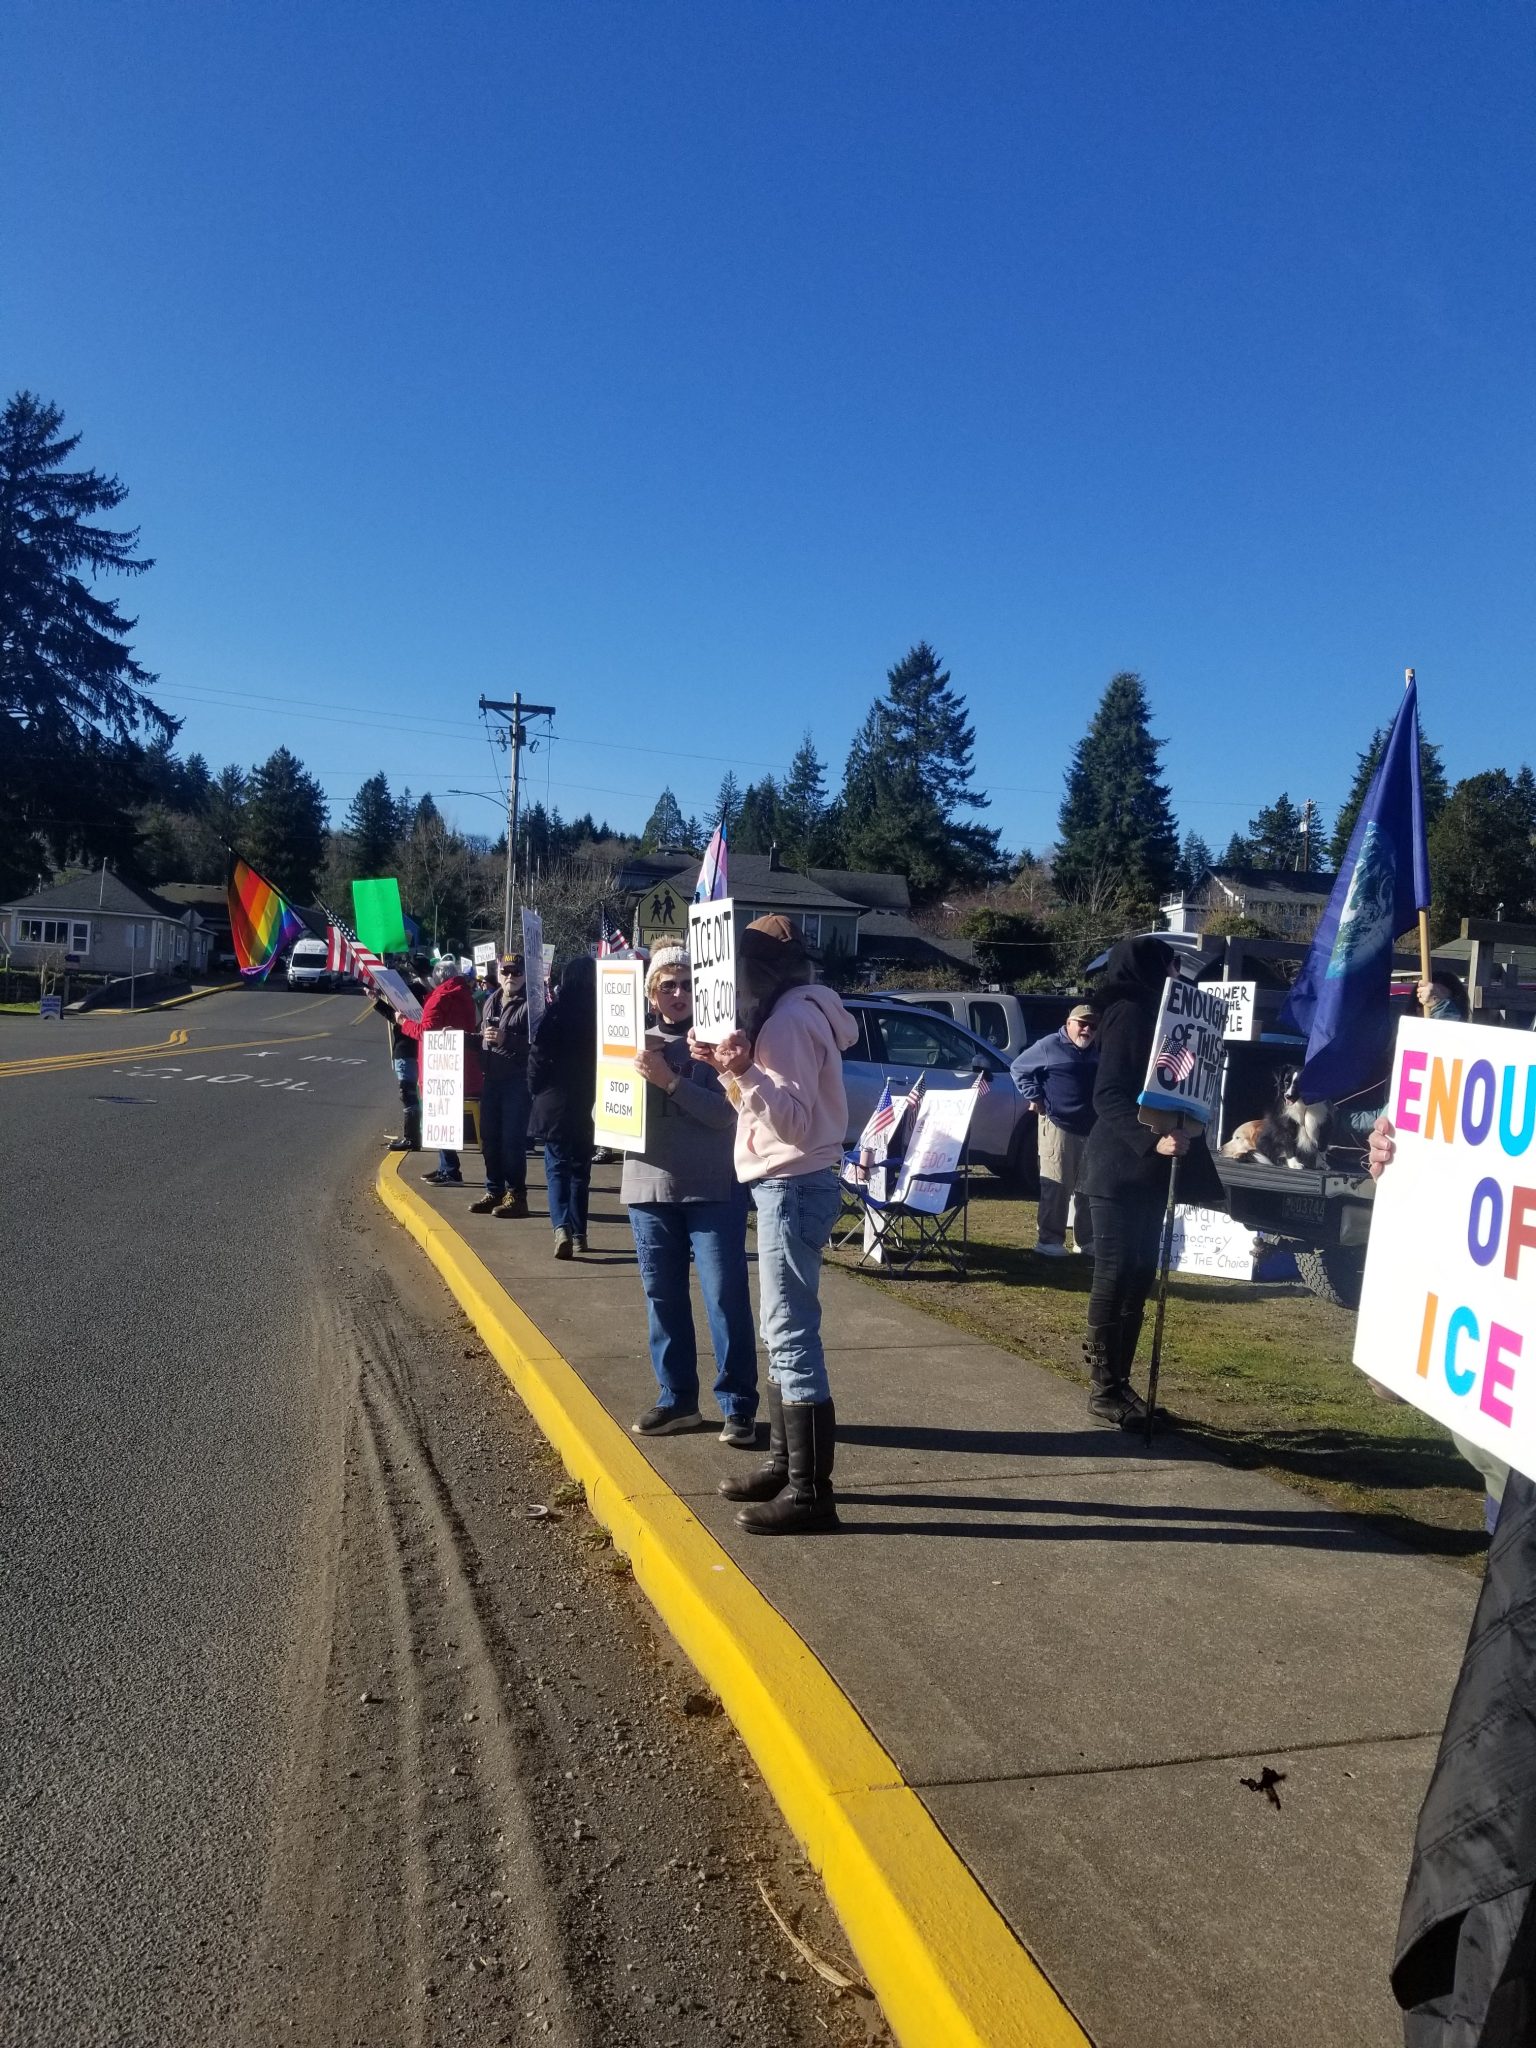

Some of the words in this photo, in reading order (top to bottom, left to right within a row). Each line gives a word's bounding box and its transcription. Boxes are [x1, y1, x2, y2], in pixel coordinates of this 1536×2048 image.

[692, 916, 713, 971] ICE
[714, 910, 731, 964] OUT
[604, 982, 617, 995] ICE
[617, 982, 632, 995] OUT
[1207, 986, 1251, 1002] POWER
[611, 1004, 625, 1016] FOR
[694, 976, 710, 1029] FOR
[713, 979, 735, 1024] GOOD
[1166, 981, 1229, 1032] ENOUGH
[608, 1024, 630, 1038] GOOD
[1172, 1023, 1195, 1046] OF
[428, 1033, 457, 1051] REGIME
[427, 1053, 460, 1072] CHANGE
[427, 1079, 456, 1096] STARTS
[610, 1081, 630, 1094] STOP
[438, 1099, 450, 1116] AT
[605, 1101, 633, 1117] FACISM
[1396, 1050, 1536, 1157] ENOU
[426, 1125, 455, 1143] HOME
[1467, 1177, 1536, 1281] OF
[1193, 1252, 1213, 1266] THE
[1217, 1254, 1250, 1269] Choice
[1416, 1291, 1523, 1428] ICE
